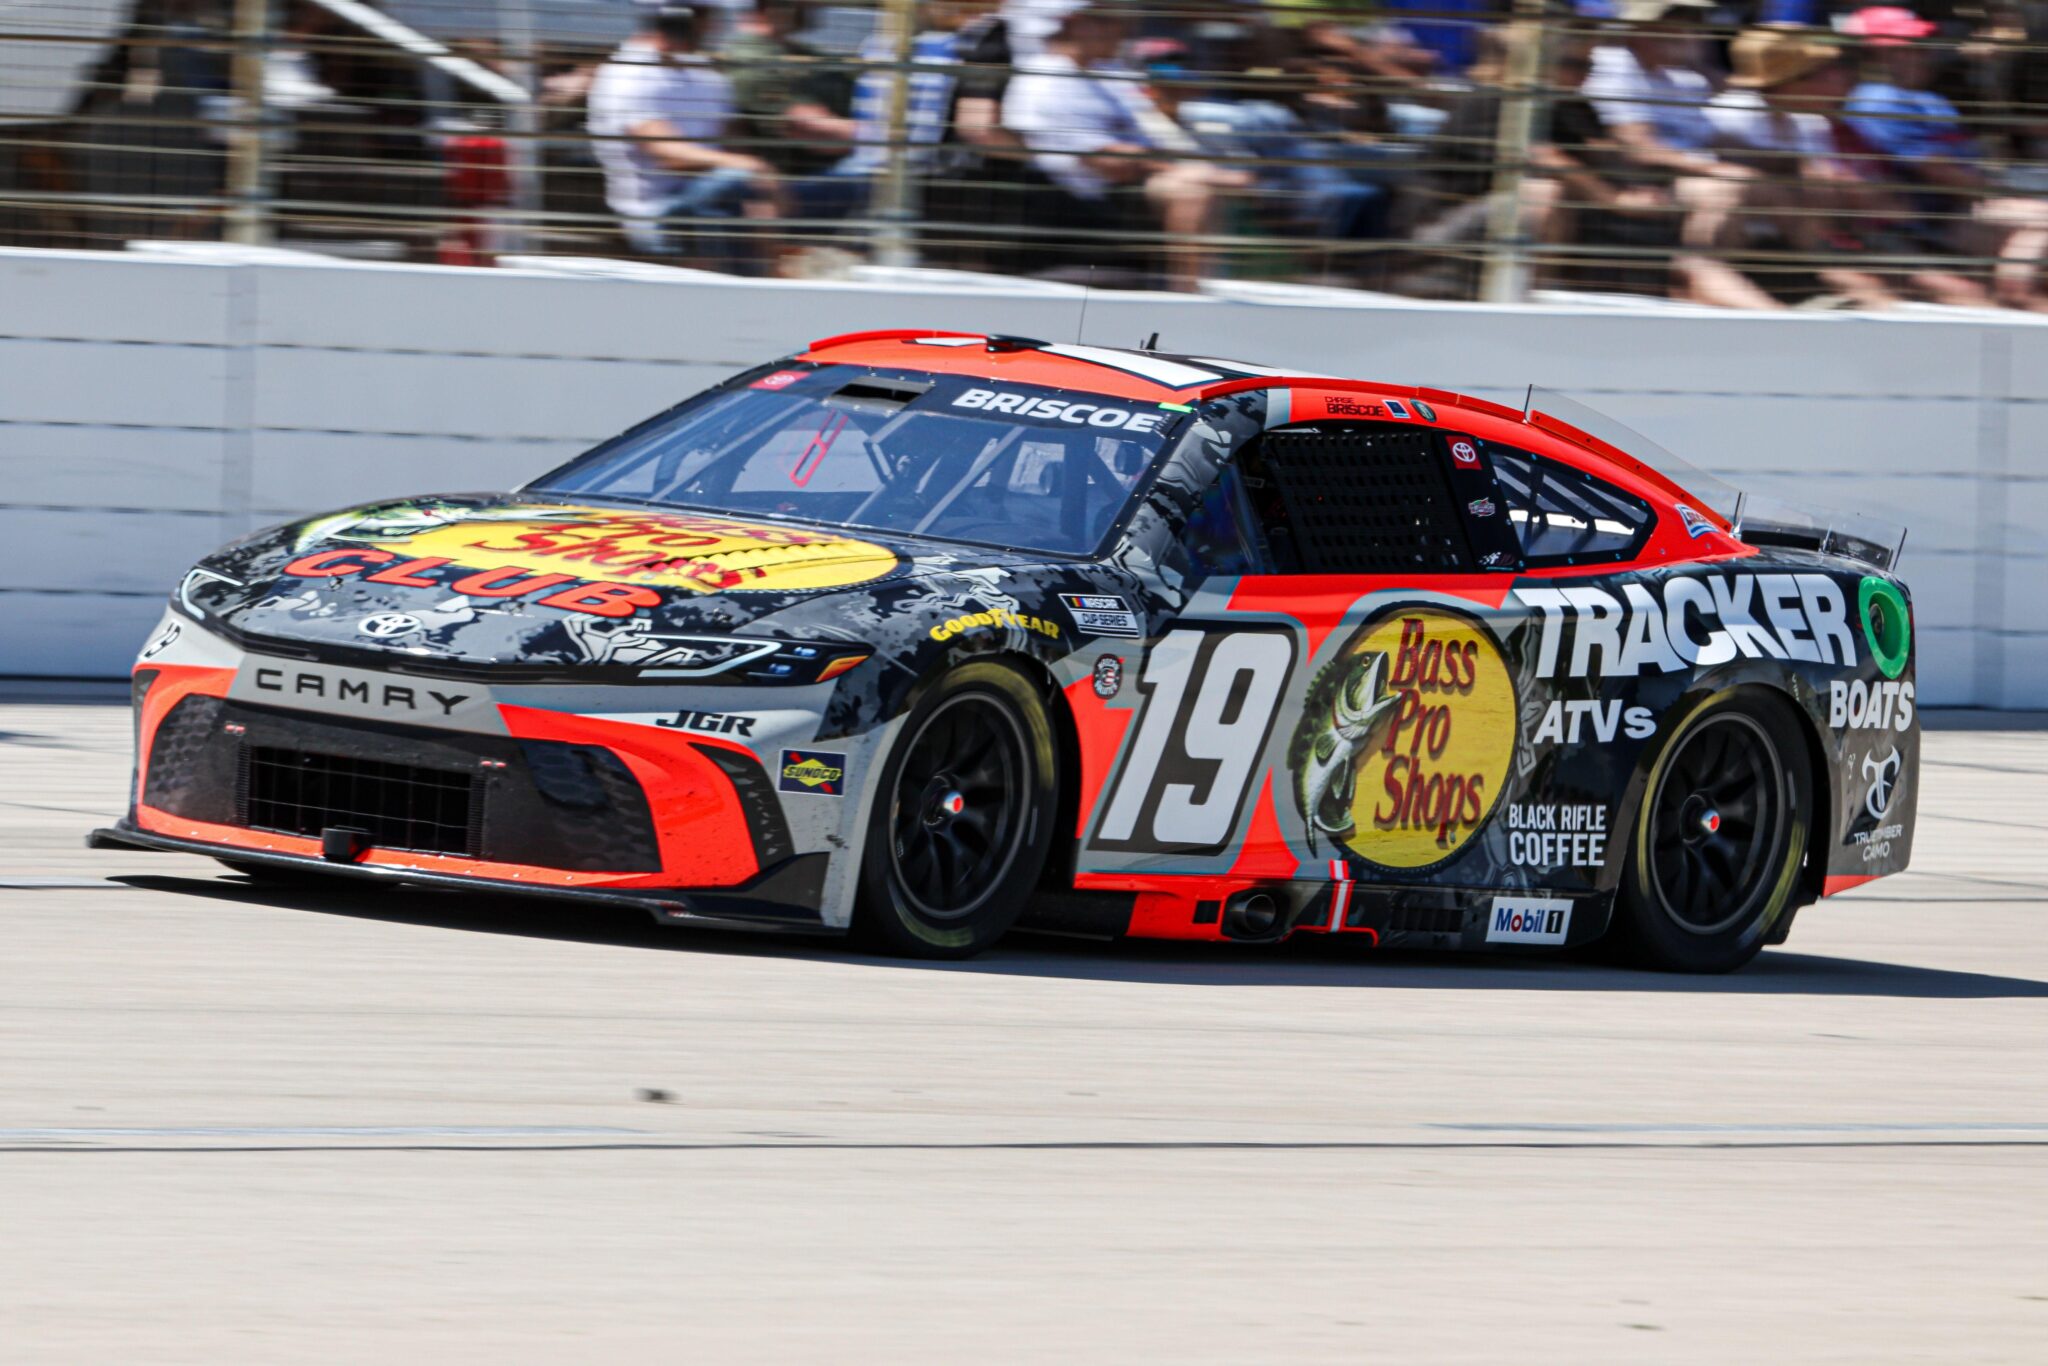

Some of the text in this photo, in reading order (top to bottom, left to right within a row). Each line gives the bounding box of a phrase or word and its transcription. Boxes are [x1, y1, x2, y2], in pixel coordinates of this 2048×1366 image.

[952, 388, 1163, 432] BRISCOE
[1327, 403, 1385, 416] BRISCOE
[283, 548, 662, 617] CLUB
[1082, 613, 1128, 627] CUP SERIES
[1083, 598, 1120, 610] NASCAR
[929, 608, 1060, 642] GOODYEAR
[1513, 573, 1857, 678] TRACKER
[1389, 617, 1479, 692] Bass
[256, 668, 470, 715] CAMRY
[1829, 679, 1915, 732] BOATS
[656, 709, 757, 737] JGR
[1098, 629, 1262, 845] 19
[1382, 688, 1451, 758] Pro
[1533, 699, 1657, 744] ATVs
[784, 765, 842, 780] SUNOCO
[1374, 753, 1485, 847] Shops
[1508, 804, 1607, 831] BLACK RIFLE
[1509, 831, 1606, 867] COFFEE
[1854, 824, 1902, 845] TRUBER
[1862, 841, 1890, 861] CAMO
[1495, 908, 1545, 933] Mobil
